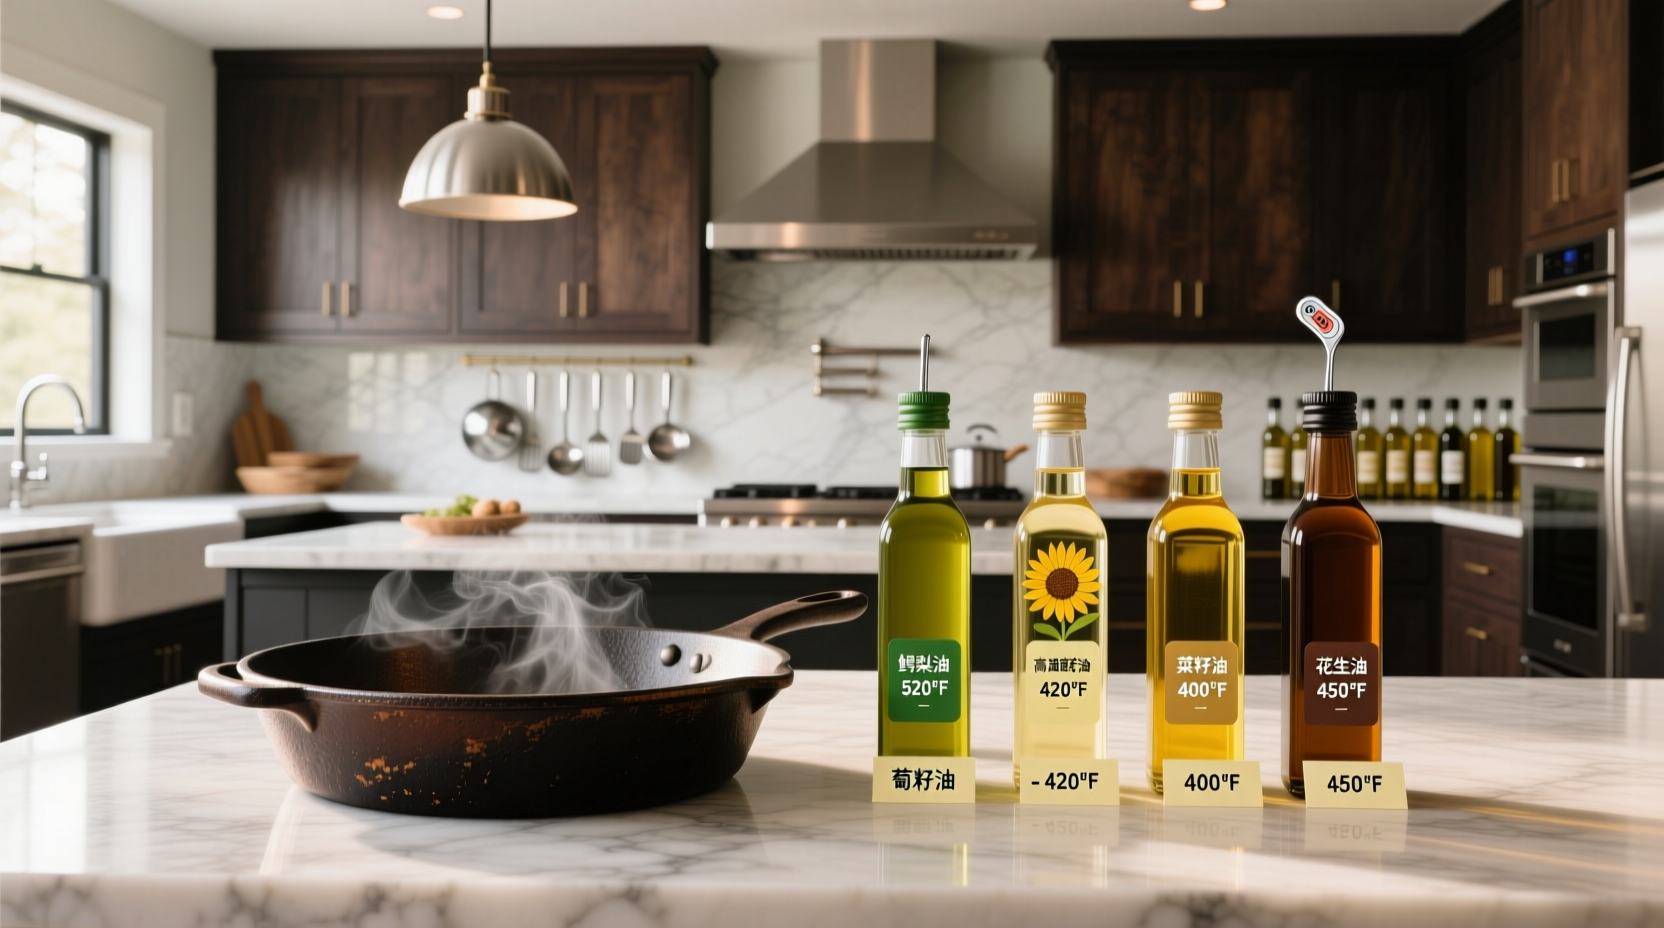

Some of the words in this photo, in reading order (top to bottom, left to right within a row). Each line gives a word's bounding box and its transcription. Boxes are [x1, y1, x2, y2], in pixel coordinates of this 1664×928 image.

[1177, 656, 1227, 674] 菜籽油
[1316, 656, 1367, 675] 花生油
